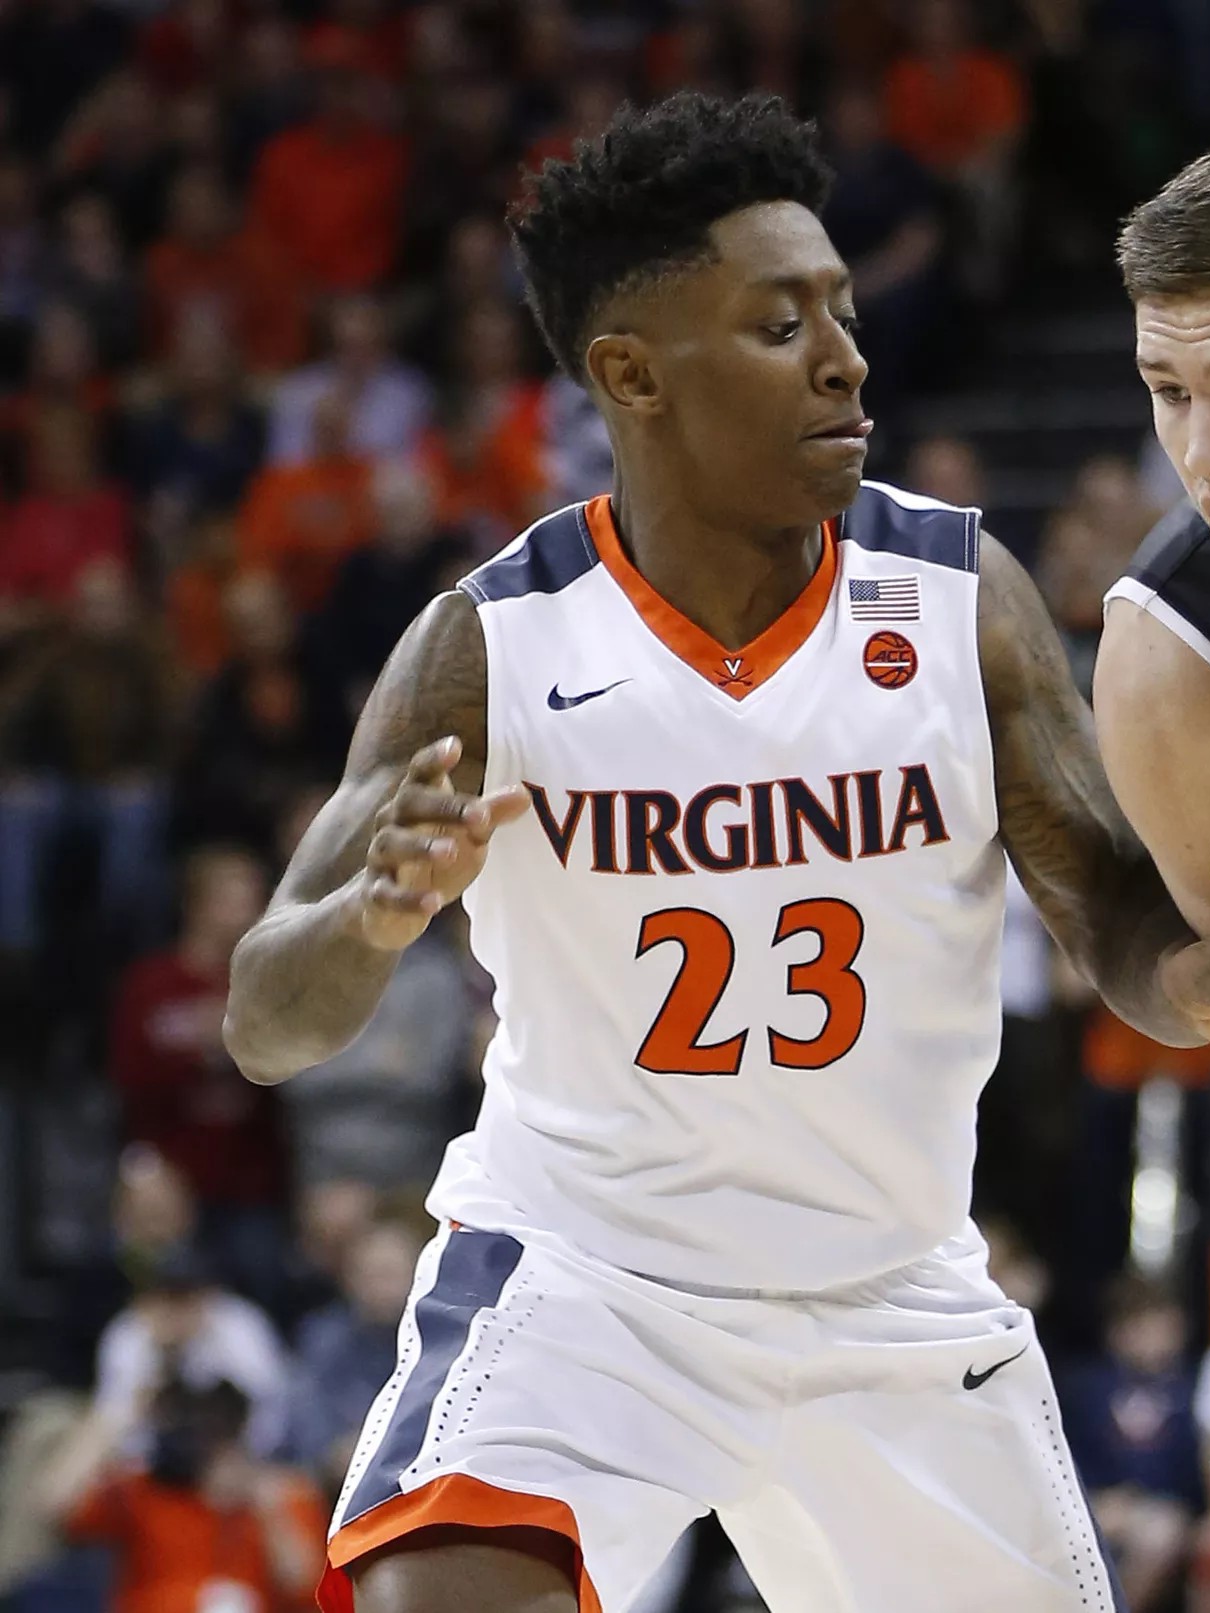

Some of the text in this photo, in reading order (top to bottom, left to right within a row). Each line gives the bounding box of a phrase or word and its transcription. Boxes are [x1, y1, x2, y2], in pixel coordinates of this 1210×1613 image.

[871, 650, 911, 663] ACC
[521, 763, 951, 875] VIRGINIA
[634, 897, 867, 1075] 23
